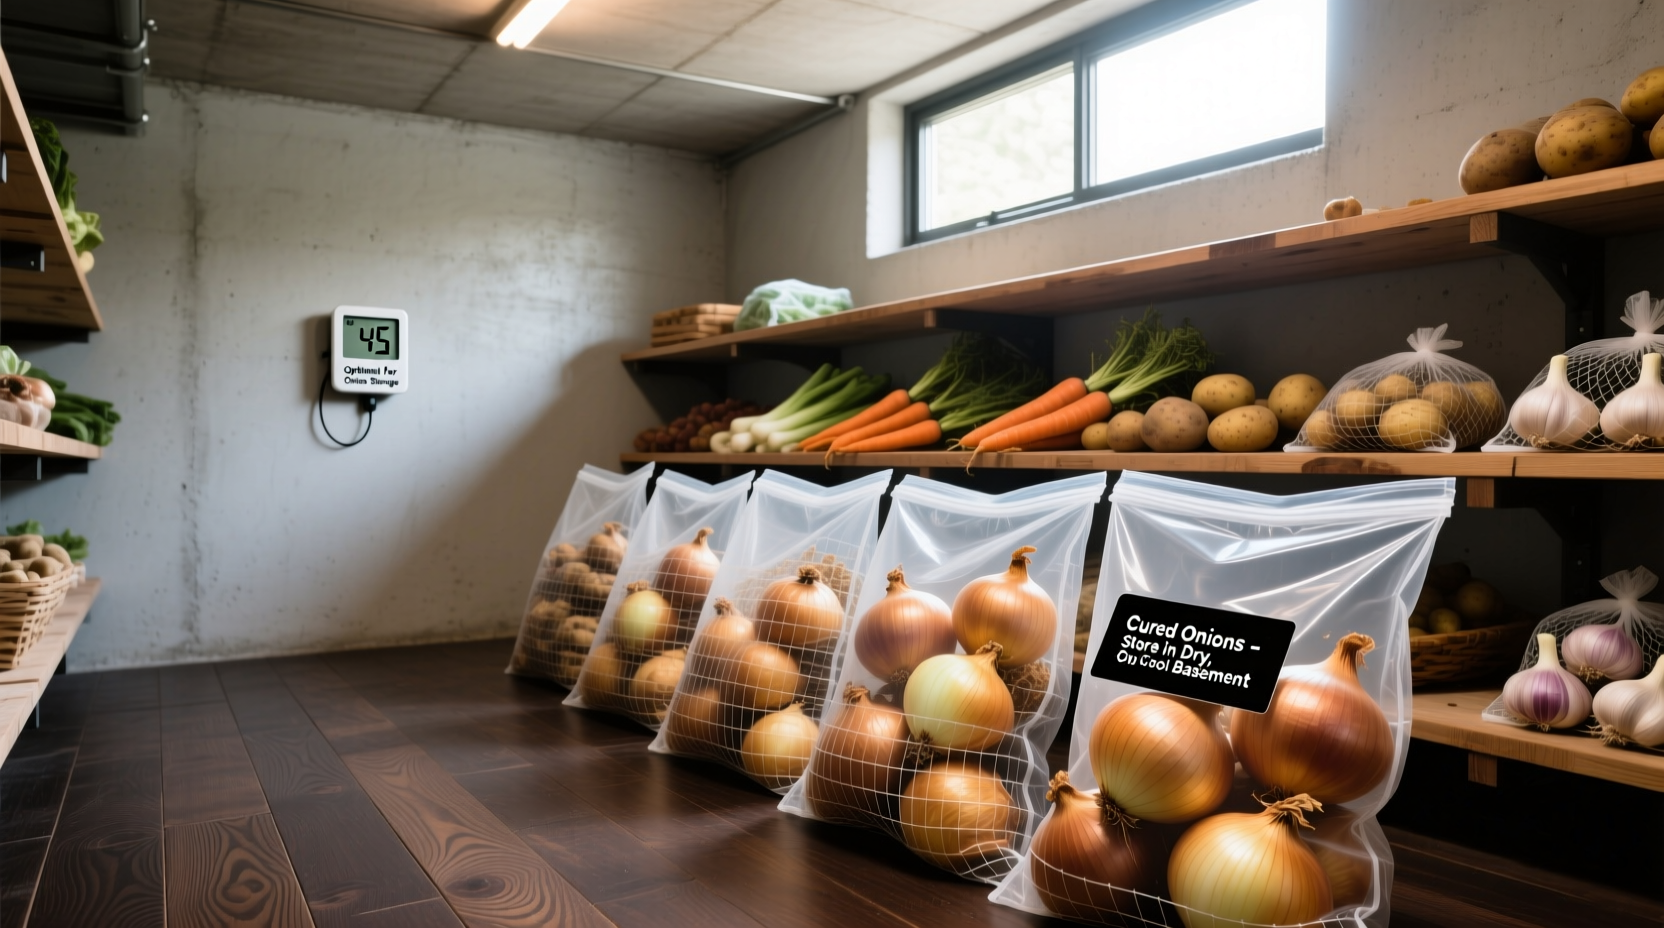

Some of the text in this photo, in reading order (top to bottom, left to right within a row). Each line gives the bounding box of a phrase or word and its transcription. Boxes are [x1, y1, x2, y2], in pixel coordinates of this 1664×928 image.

[360, 326, 389, 355] 45
[1126, 614, 1179, 639] Cured
[1181, 625, 1245, 652] Onions
[1120, 634, 1159, 654] Store
[1180, 644, 1212, 668] Dry,
[1139, 654, 1170, 672] Cool
[1172, 660, 1251, 689] Basement
